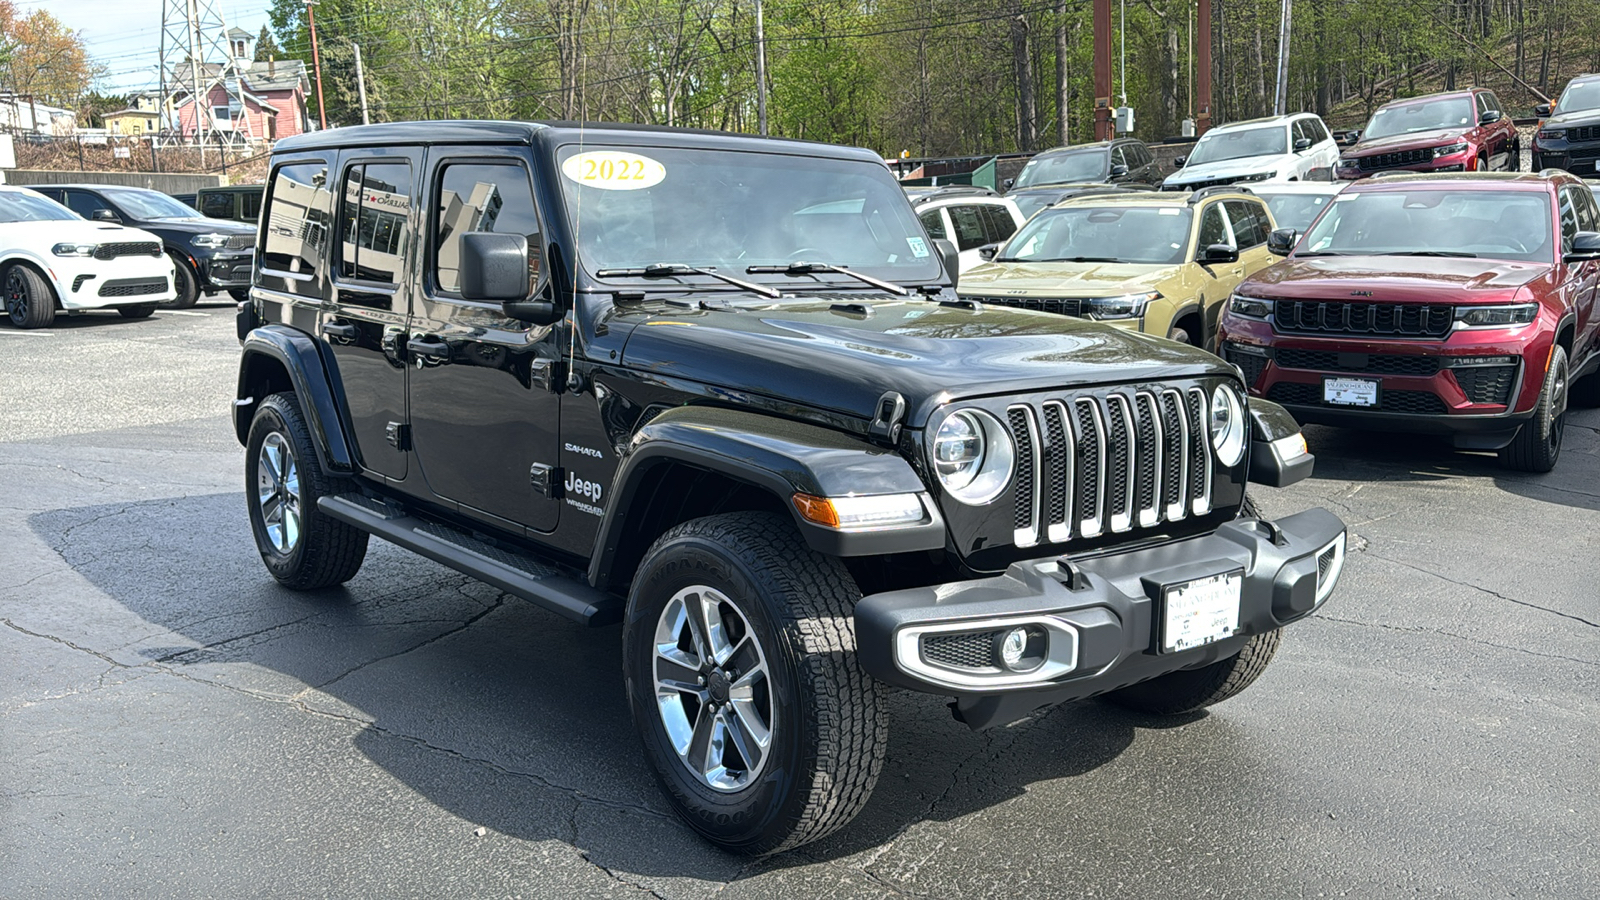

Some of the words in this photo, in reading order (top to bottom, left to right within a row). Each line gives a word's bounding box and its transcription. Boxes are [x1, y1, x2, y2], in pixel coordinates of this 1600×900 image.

[583, 159, 645, 180] 2022
[564, 442, 603, 458] SAHARA
[564, 471, 602, 503] Jeep
